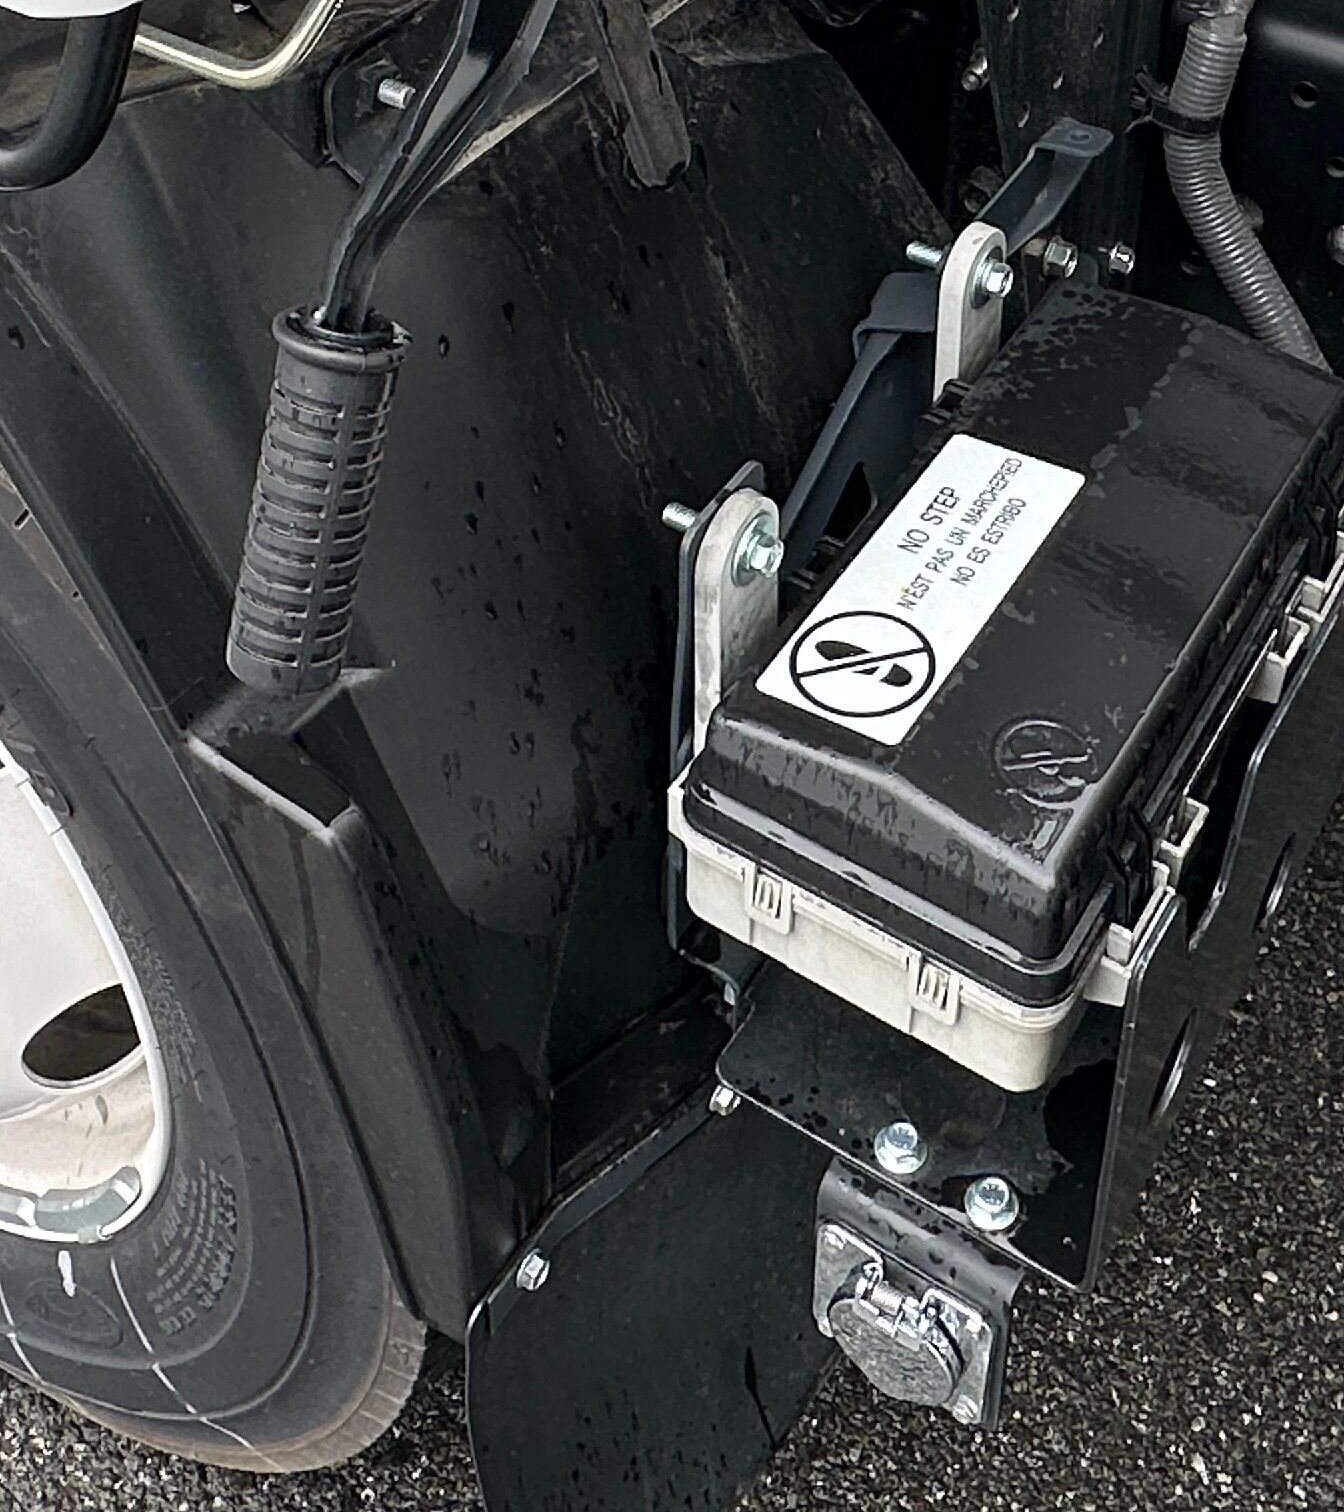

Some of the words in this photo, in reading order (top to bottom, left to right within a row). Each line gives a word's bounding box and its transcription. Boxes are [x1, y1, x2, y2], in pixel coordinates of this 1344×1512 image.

[897, 528, 930, 555] NO
[920, 486, 960, 525] STEP
[925, 548, 954, 573] PAS
[944, 527, 971, 546] UN
[960, 458, 1022, 525] MARCHEPIED
[950, 566, 976, 586] NO
[967, 547, 991, 564] ES
[981, 498, 1027, 545] ESTRIBO
